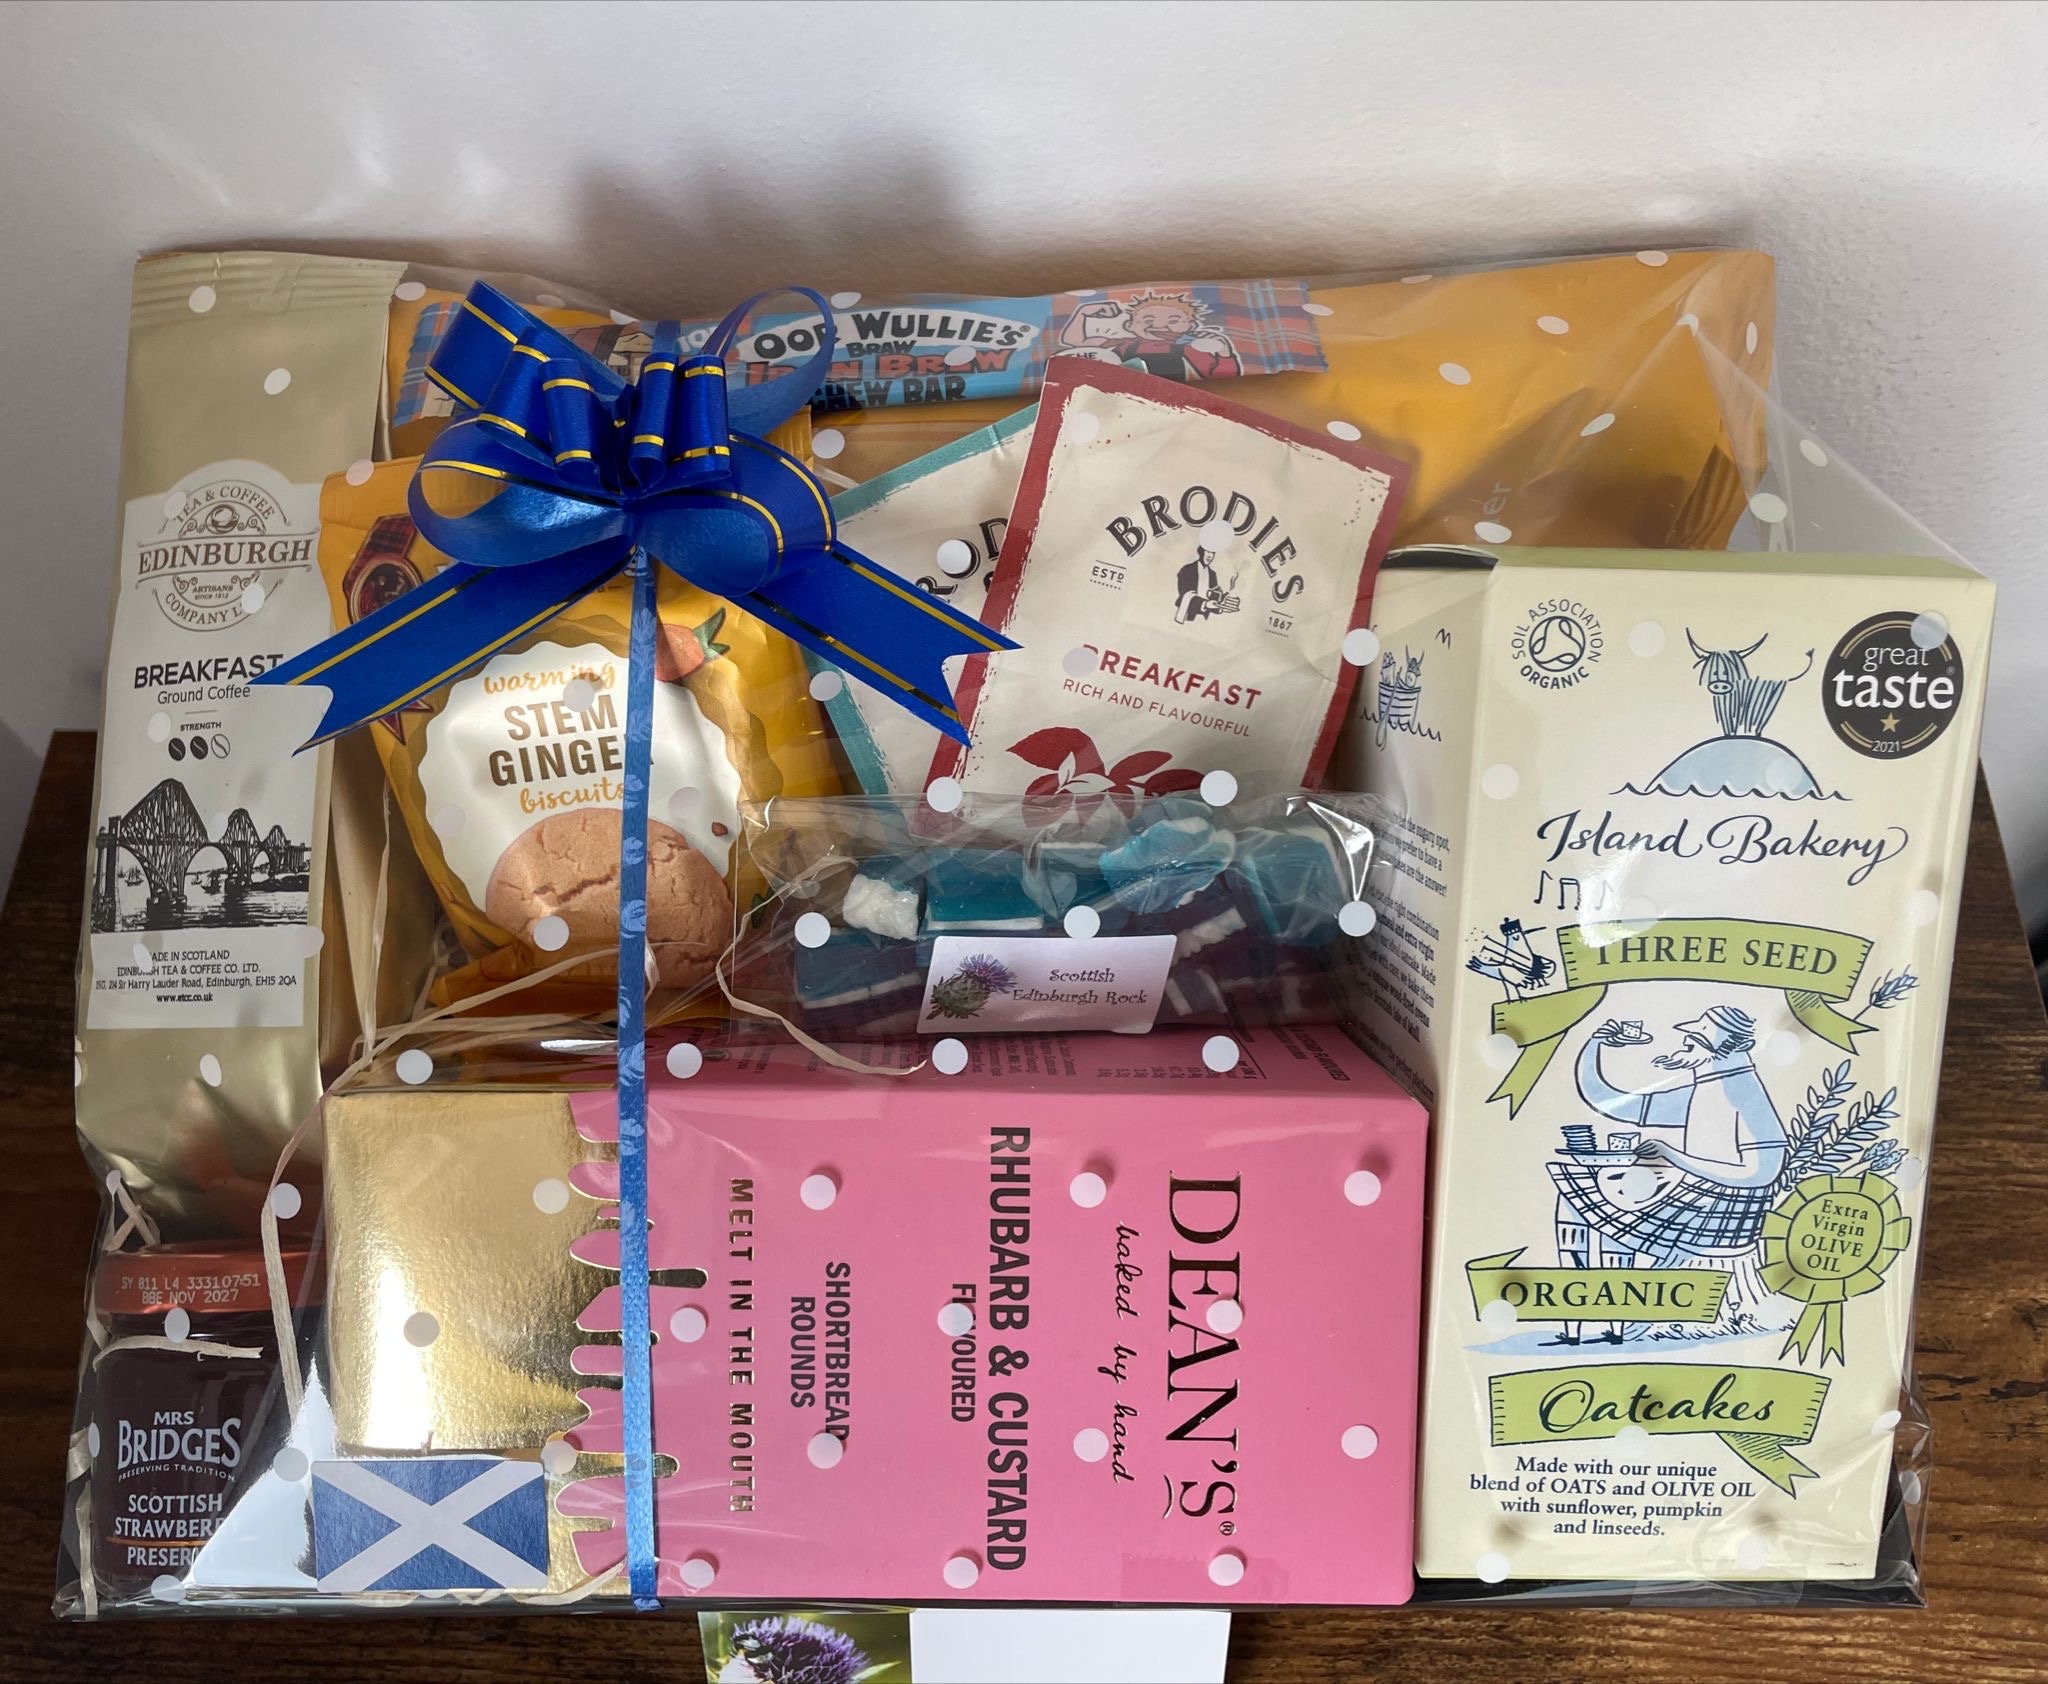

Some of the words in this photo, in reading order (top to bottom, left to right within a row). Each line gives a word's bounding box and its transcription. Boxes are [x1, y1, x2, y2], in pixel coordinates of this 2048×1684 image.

[812, 379, 893, 411] HEW
[903, 375, 967, 403] BAR
[173, 496, 202, 525] TEA
[204, 489, 215, 501] &
[219, 484, 276, 521] COFFEE
[138, 538, 314, 576] EDINBURGH
[1105, 484, 1305, 604] BRODIES
[166, 592, 229, 625] COMPANY
[1268, 616, 1293, 631] 1867
[1511, 625, 1531, 660] SOIL
[1528, 598, 1604, 663] ASSOCIATION
[134, 653, 284, 689] BREAKFAST
[1864, 644, 1930, 670] great
[483, 661, 616, 695] warming
[1083, 643, 1263, 713] REAKFAST
[1520, 664, 1590, 690] ORGANIC
[1831, 672, 1955, 710] taste
[157, 686, 204, 705] Ground
[208, 684, 251, 701] Coffee
[1063, 678, 1104, 700] RICH
[1107, 690, 1144, 712] AND
[1149, 699, 1251, 738] FLAVOURFUL
[180, 721, 222, 732] STRENGTH
[504, 694, 619, 741] STEM
[488, 733, 655, 787] GINGE
[1872, 739, 1900, 754] 2021
[519, 776, 625, 814] biscuits
[1537, 809, 1702, 862] Island
[1706, 814, 1909, 887] Bakery
[117, 966, 160, 977] EDINBUH
[161, 964, 178, 975] TEA
[180, 964, 187, 975] &
[189, 963, 222, 975] COFFEE
[224, 963, 240, 974] CO.
[242, 962, 261, 974] LTD.
[150, 951, 169, 962] ADE
[170, 951, 180, 961] IN
[182, 949, 230, 961] SCOTLAND
[1597, 935, 1728, 966] THREE
[1743, 938, 1839, 976] SEED
[128, 978, 151, 991] Harry
[153, 977, 179, 989] Lauder
[181, 977, 204, 989] Road,
[206, 976, 253, 989] Edinburgh,
[255, 975, 276, 986] EH15
[278, 975, 297, 987] 2QA
[1049, 968, 1116, 983] Scottish
[1012, 988, 1098, 1006] Edinburgh
[1105, 990, 1148, 1006] Rock
[729, 1177, 755, 1262] MELT
[1811, 1213, 1866, 1238] Virgin
[1819, 1198, 1870, 1221] Extra
[989, 1126, 1031, 1331] RHUBARB
[1800, 1233, 1865, 1258] OLIVE
[1115, 1220, 1140, 1321] baked
[1806, 1253, 1842, 1274] OIL
[142, 1291, 163, 1305] BBE
[169, 1290, 196, 1305] NOV
[203, 1288, 239, 1304] 2027
[164, 1276, 180, 1290] L4
[729, 1280, 755, 1311] IN
[1500, 1280, 1697, 1309] ORGANIC
[729, 1326, 755, 1386] THE
[790, 1296, 816, 1408] ROUNDS
[825, 1261, 851, 1441] SHORTBREAD
[950, 1283, 977, 1423] FLVOURED
[1166, 1169, 1242, 1518] DEAN'S
[987, 1344, 1030, 1378] &
[1097, 1341, 1139, 1385] by
[153, 1411, 194, 1426] MRS
[1538, 1373, 1775, 1434] Oatcakes
[118, 1417, 242, 1470] BRIDGES
[729, 1402, 755, 1513] MOUTH
[1111, 1401, 1139, 1484] hand
[118, 1463, 170, 1483] PRESERVING
[174, 1463, 236, 1483] TRADITION
[987, 1391, 1029, 1571] CUSTARD
[1515, 1455, 1568, 1475] Made
[1573, 1457, 1613, 1476] with
[1619, 1462, 1652, 1476] our
[1656, 1460, 1718, 1482] unique
[128, 1492, 223, 1514] SCOTTISH
[1470, 1474, 1521, 1494] blend
[1525, 1476, 1547, 1494] of
[1550, 1476, 1606, 1495] OATS
[1611, 1477, 1645, 1496] and
[1651, 1479, 1715, 1498] OLIVE
[1720, 1480, 1756, 1498] OIL
[1500, 1497, 1541, 1514] with
[1546, 1497, 1638, 1518] sunflower,
[1642, 1500, 1723, 1523] pumpkin
[114, 1516, 225, 1539] STRAWBER
[1553, 1518, 1586, 1535] and
[1592, 1518, 1666, 1537] linseeds.
[127, 1546, 199, 1567] PRESER
